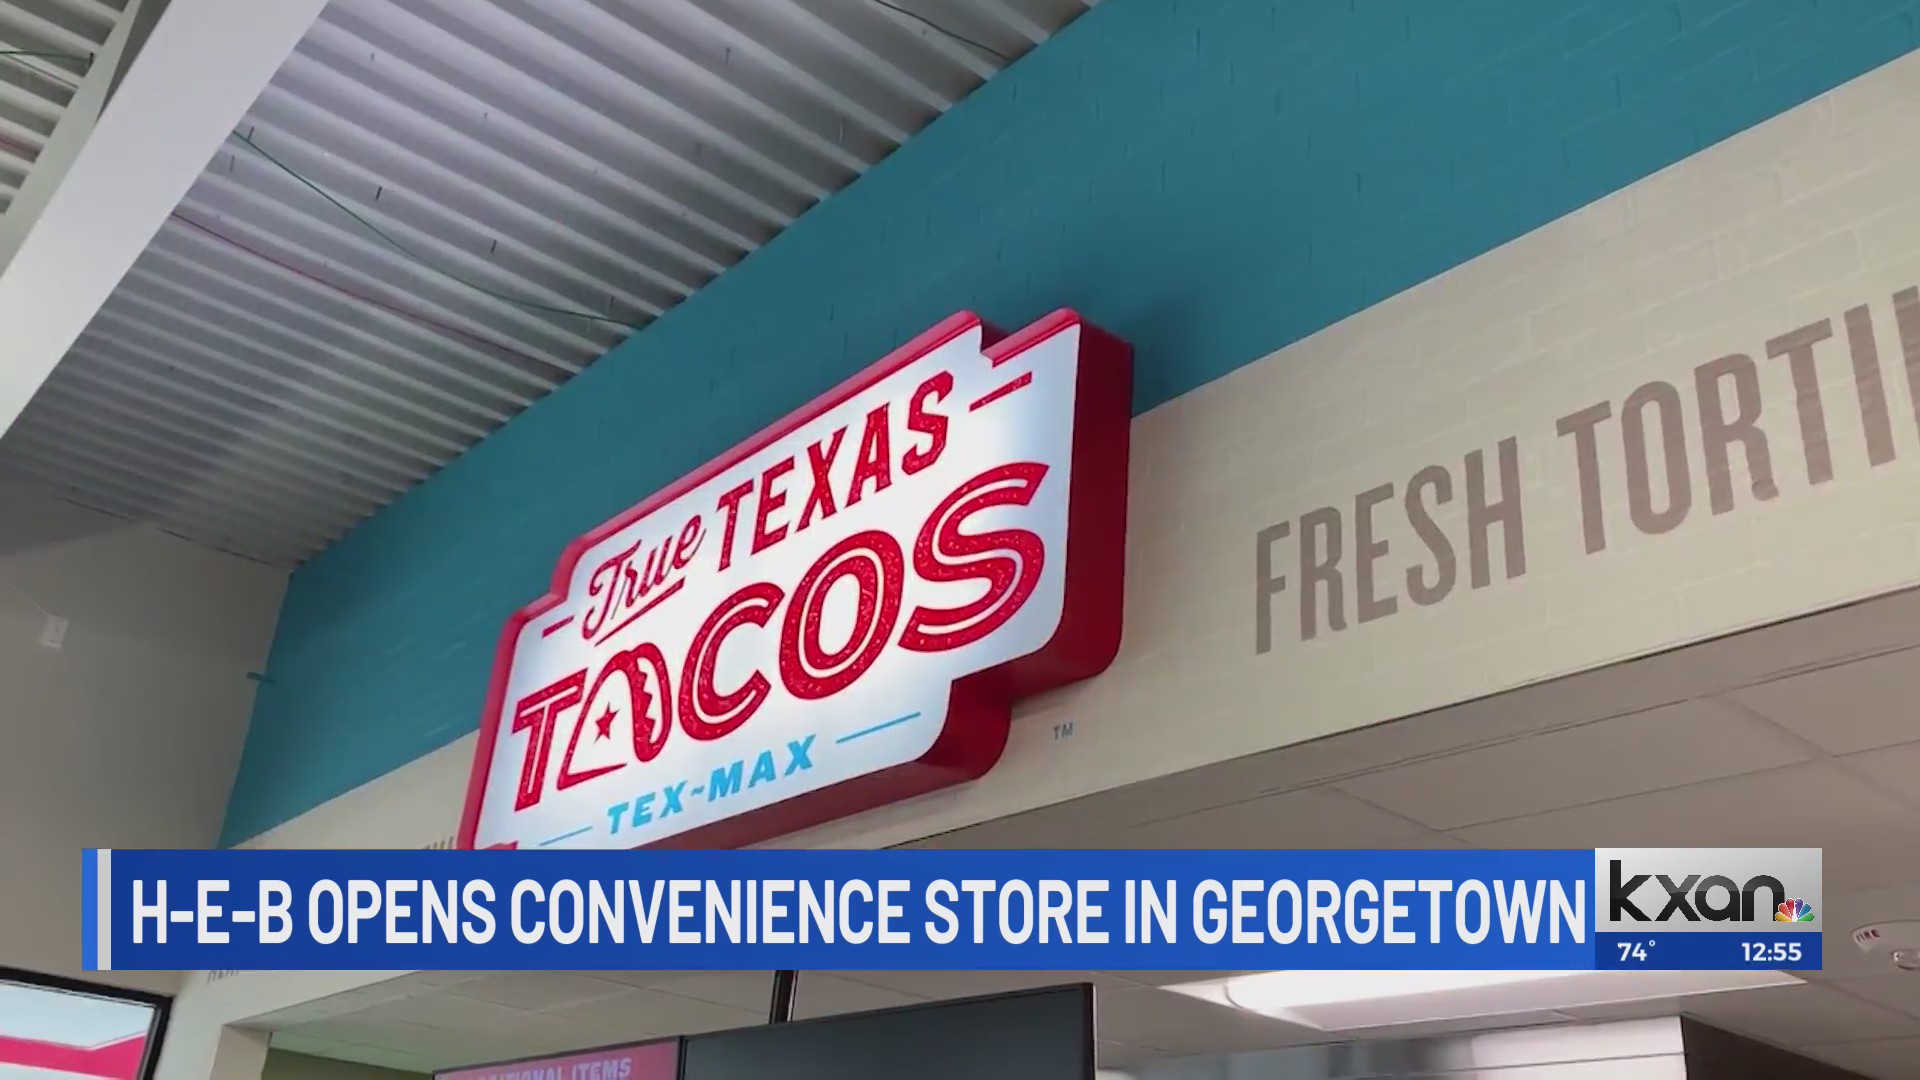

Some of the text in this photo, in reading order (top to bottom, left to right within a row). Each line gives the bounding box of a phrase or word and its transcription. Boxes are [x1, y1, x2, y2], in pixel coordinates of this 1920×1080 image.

[582, 372, 953, 639] True TEXAS
[1256, 436, 1526, 655] FRESH
[513, 463, 1048, 812] TACOS
[1053, 722, 1073, 740] TM
[572, 1057, 632, 1080] ITEMS
